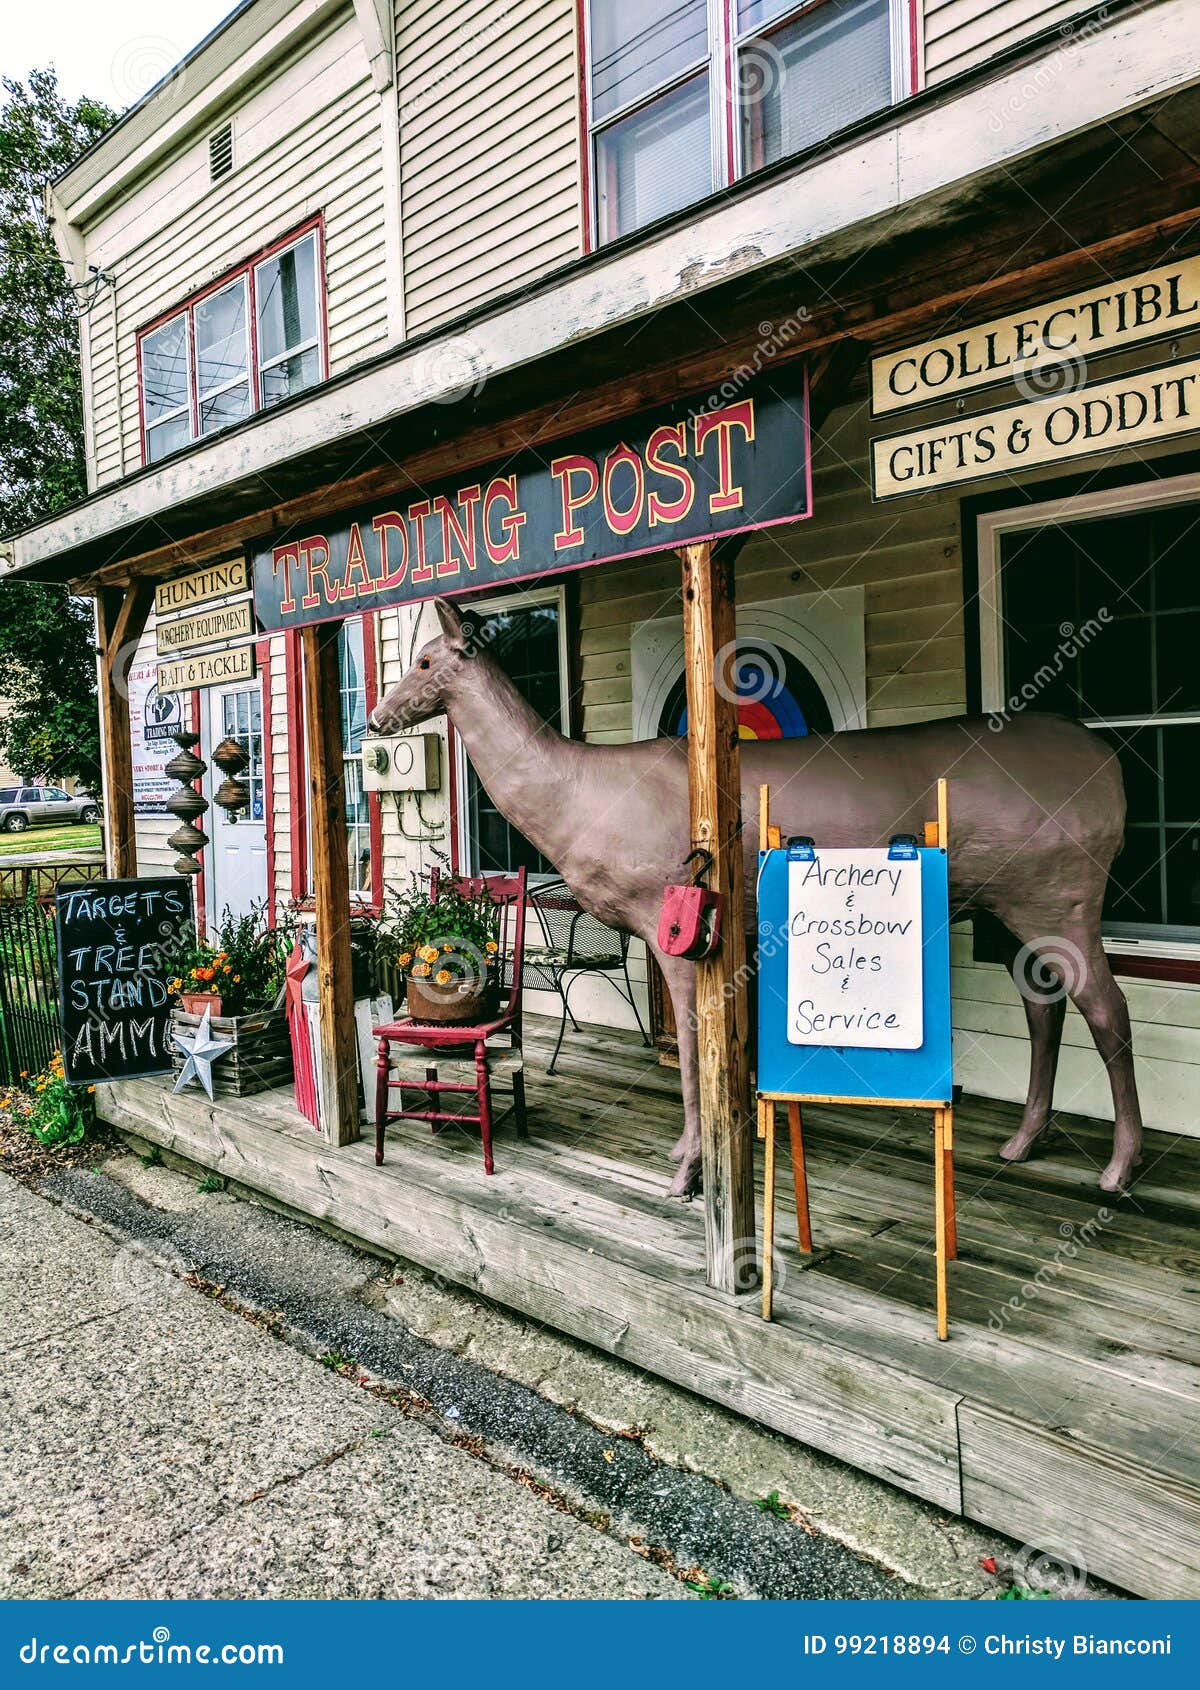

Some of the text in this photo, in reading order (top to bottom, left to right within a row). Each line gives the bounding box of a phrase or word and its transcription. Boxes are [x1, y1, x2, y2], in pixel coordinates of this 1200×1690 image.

[888, 274, 1199, 396] COLLECTIBL
[889, 374, 1200, 482] GIFTS & ODDIT
[272, 399, 755, 615] TRADING POST
[159, 563, 243, 608] HUNTING
[160, 608, 247, 647] ARCHERY EQUIPMENT
[160, 665, 185, 687] BAIT
[188, 664, 196, 681] &
[198, 652, 248, 680] TACKLE
[802, 856, 902, 896] Archery
[57, 888, 184, 925] TARGETS
[791, 911, 913, 937] Crossbow
[114, 923, 128, 946] &
[67, 942, 159, 974] TREE
[811, 942, 882, 974] Sales
[71, 976, 177, 1011] STAND
[795, 1000, 901, 1035] Service
